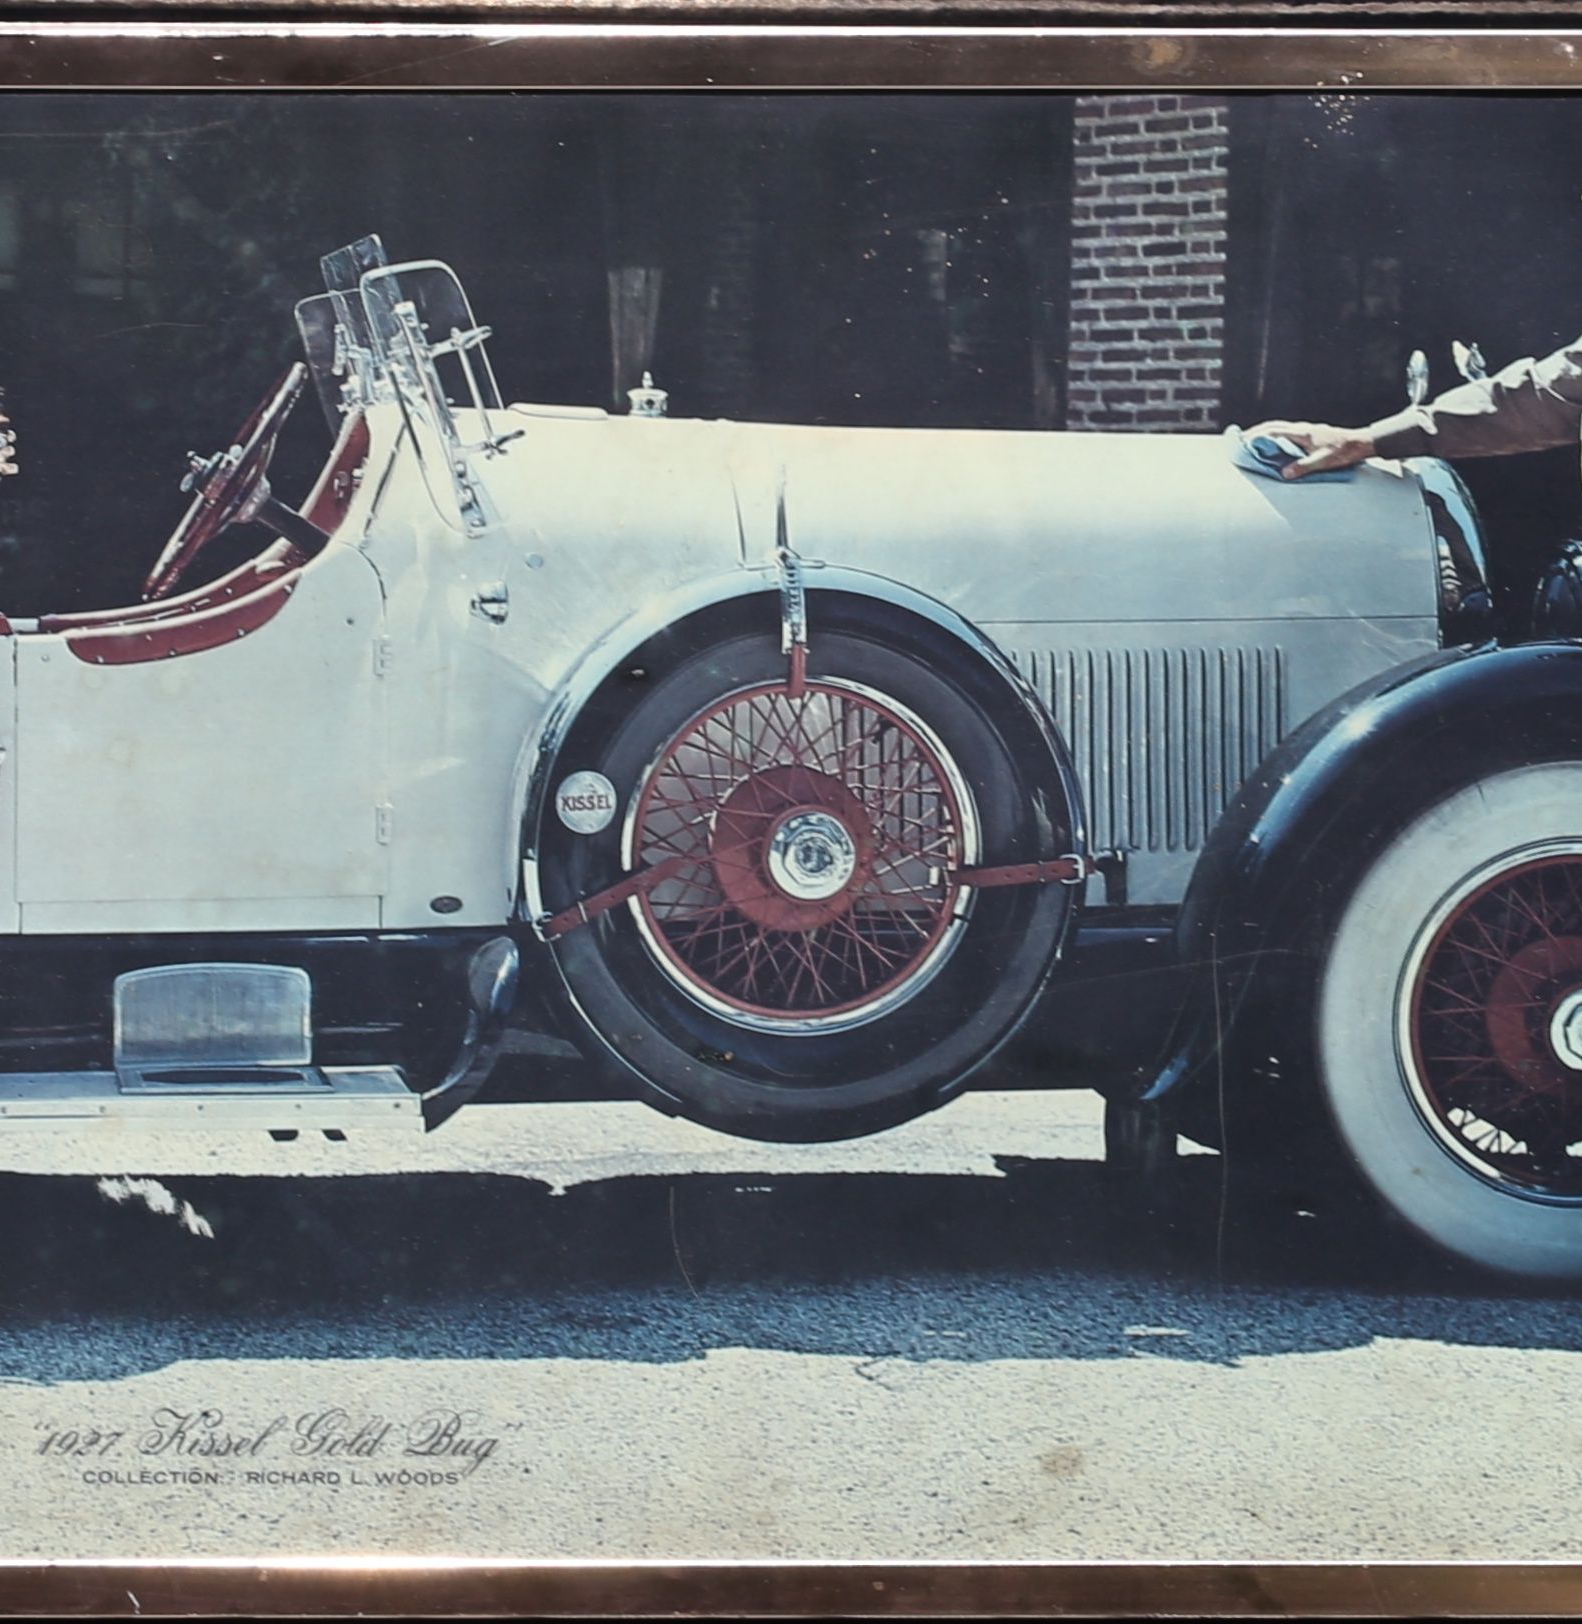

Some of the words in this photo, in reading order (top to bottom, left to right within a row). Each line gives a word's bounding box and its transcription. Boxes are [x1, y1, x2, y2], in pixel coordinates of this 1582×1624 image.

[561, 795, 612, 812] KISSEL
[137, 1407, 289, 1457] Kissel
[290, 1407, 393, 1457] Gold
[246, 1470, 341, 1485] RICHARD
[374, 1470, 460, 1486] WOODS
